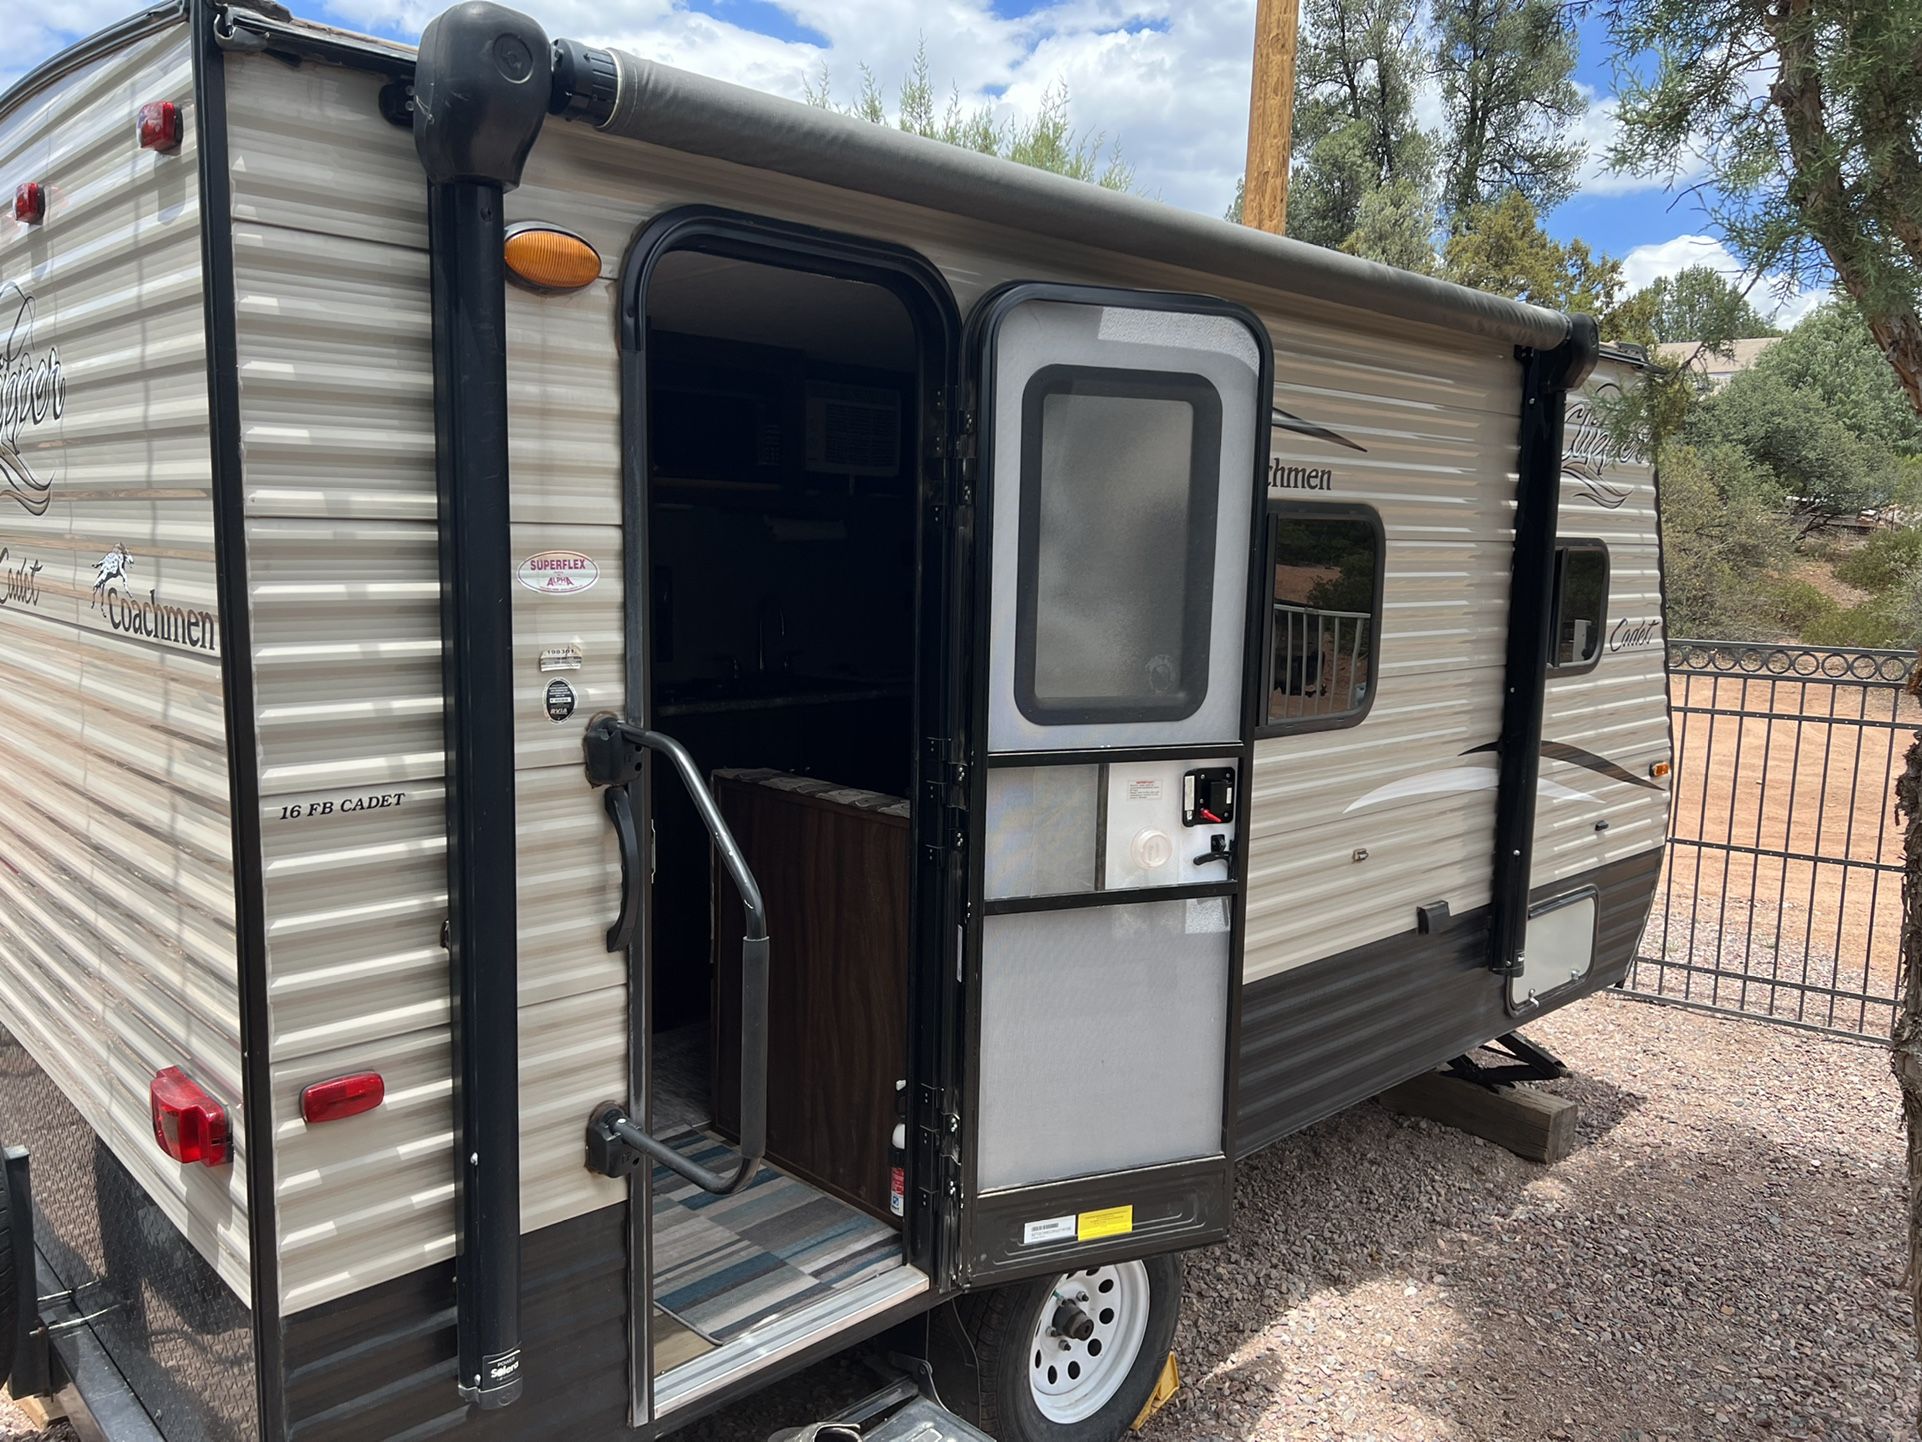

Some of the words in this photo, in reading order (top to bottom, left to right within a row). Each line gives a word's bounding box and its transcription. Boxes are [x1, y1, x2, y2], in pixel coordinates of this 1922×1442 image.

[530, 559, 586, 571] SUPERFLEX
[546, 577, 574, 586] ALPHA
[108, 587, 215, 651] Coachmen
[1610, 618, 1660, 652] Cadet
[280, 805, 302, 820] 16
[307, 801, 334, 817] FB
[340, 792, 406, 812] CADET
[490, 1360, 519, 1378] Solera
[497, 1356, 515, 1367] POWER
